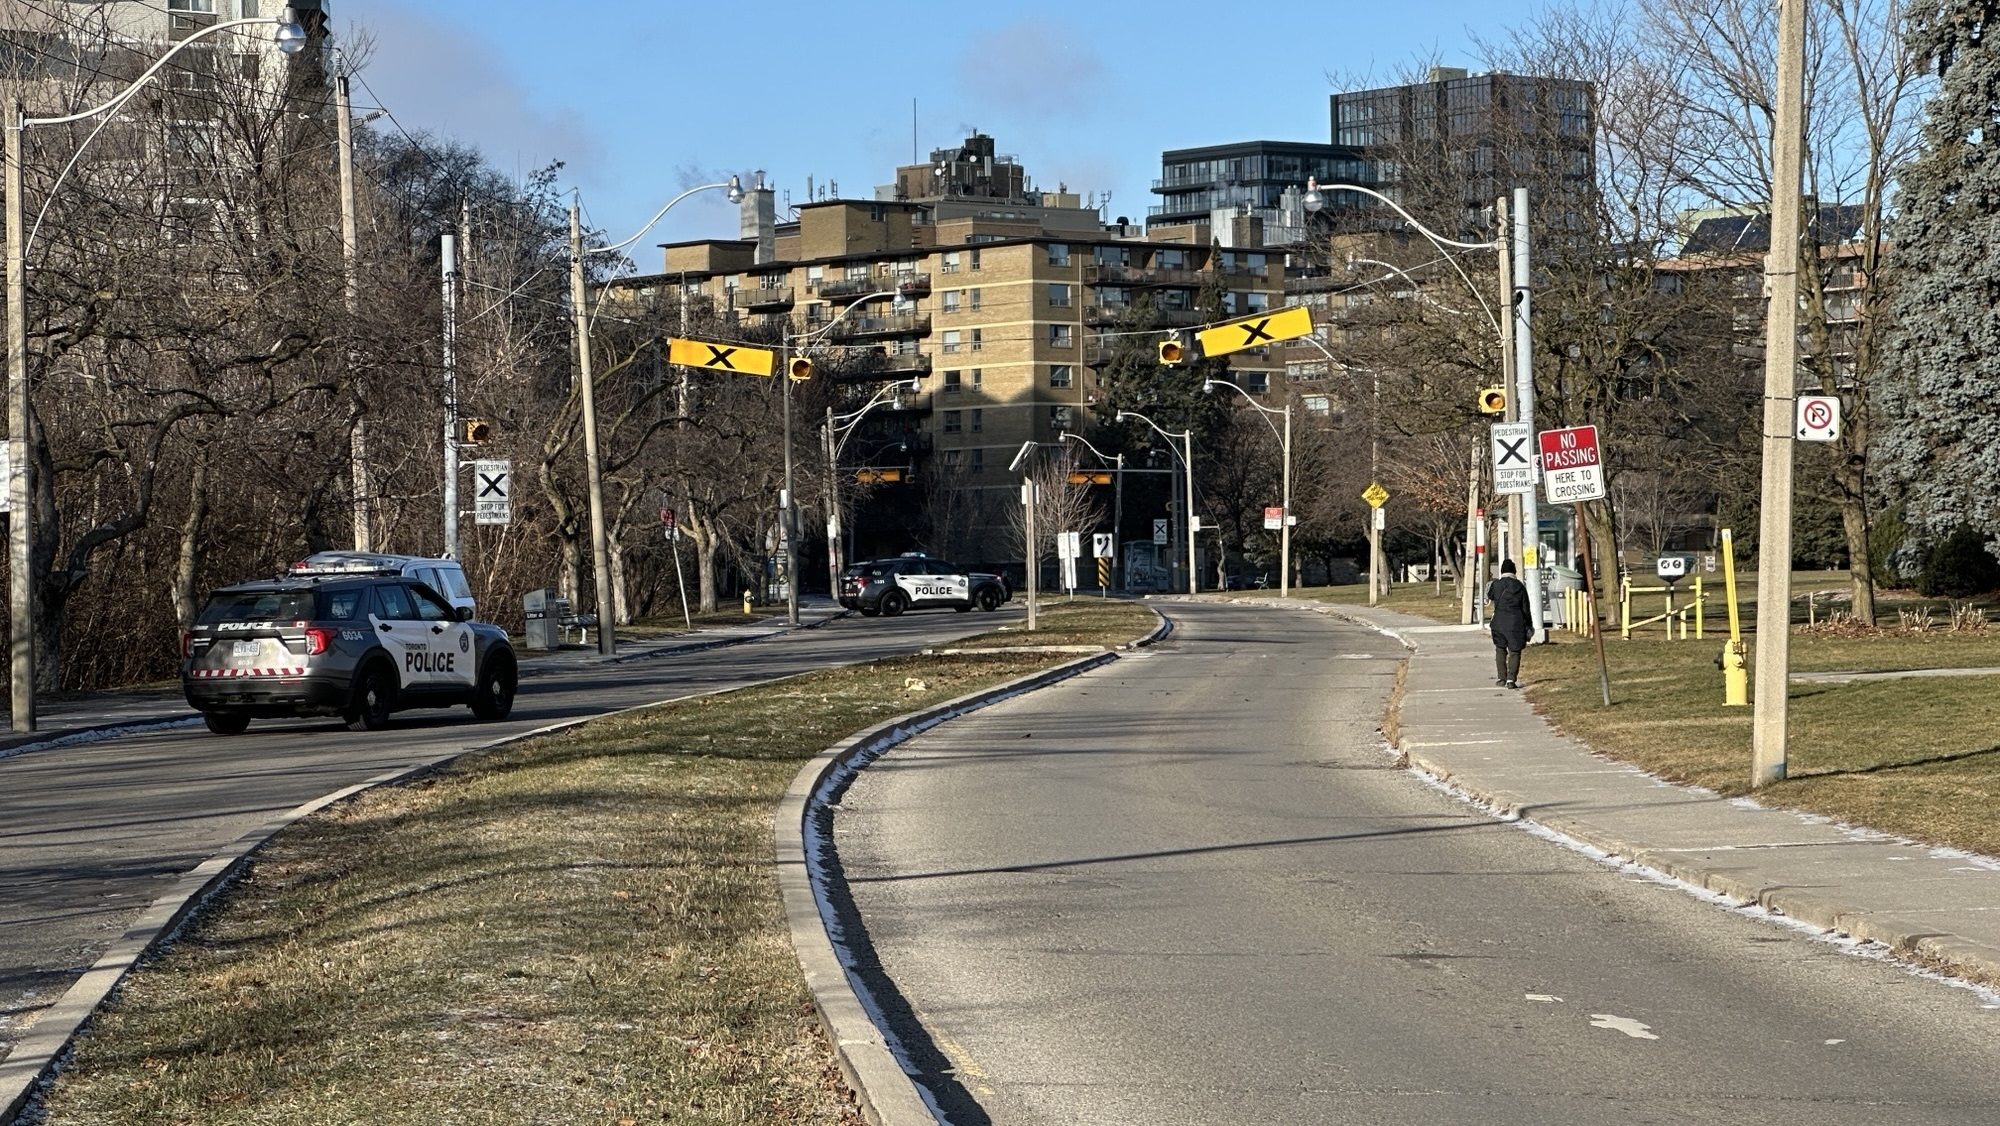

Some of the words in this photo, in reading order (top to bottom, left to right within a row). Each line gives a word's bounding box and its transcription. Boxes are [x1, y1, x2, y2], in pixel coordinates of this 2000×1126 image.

[1495, 428, 1528, 437] PEDESTRIAN
[1560, 432, 1576, 449] NO
[1546, 447, 1596, 468] PASSING
[1500, 471, 1514, 479] STOP
[1516, 470, 1527, 478] FOR
[1555, 471, 1576, 484] HERE
[1581, 469, 1592, 480] TO
[1497, 479, 1531, 488] PEDESTRIANS
[1555, 483, 1596, 498] CROSSING
[915, 586, 953, 595] POLICE
[217, 622, 274, 632] POLICE
[342, 630, 363, 641] 6034
[405, 643, 427, 651] TORONTO
[406, 652, 455, 673] POLICE
